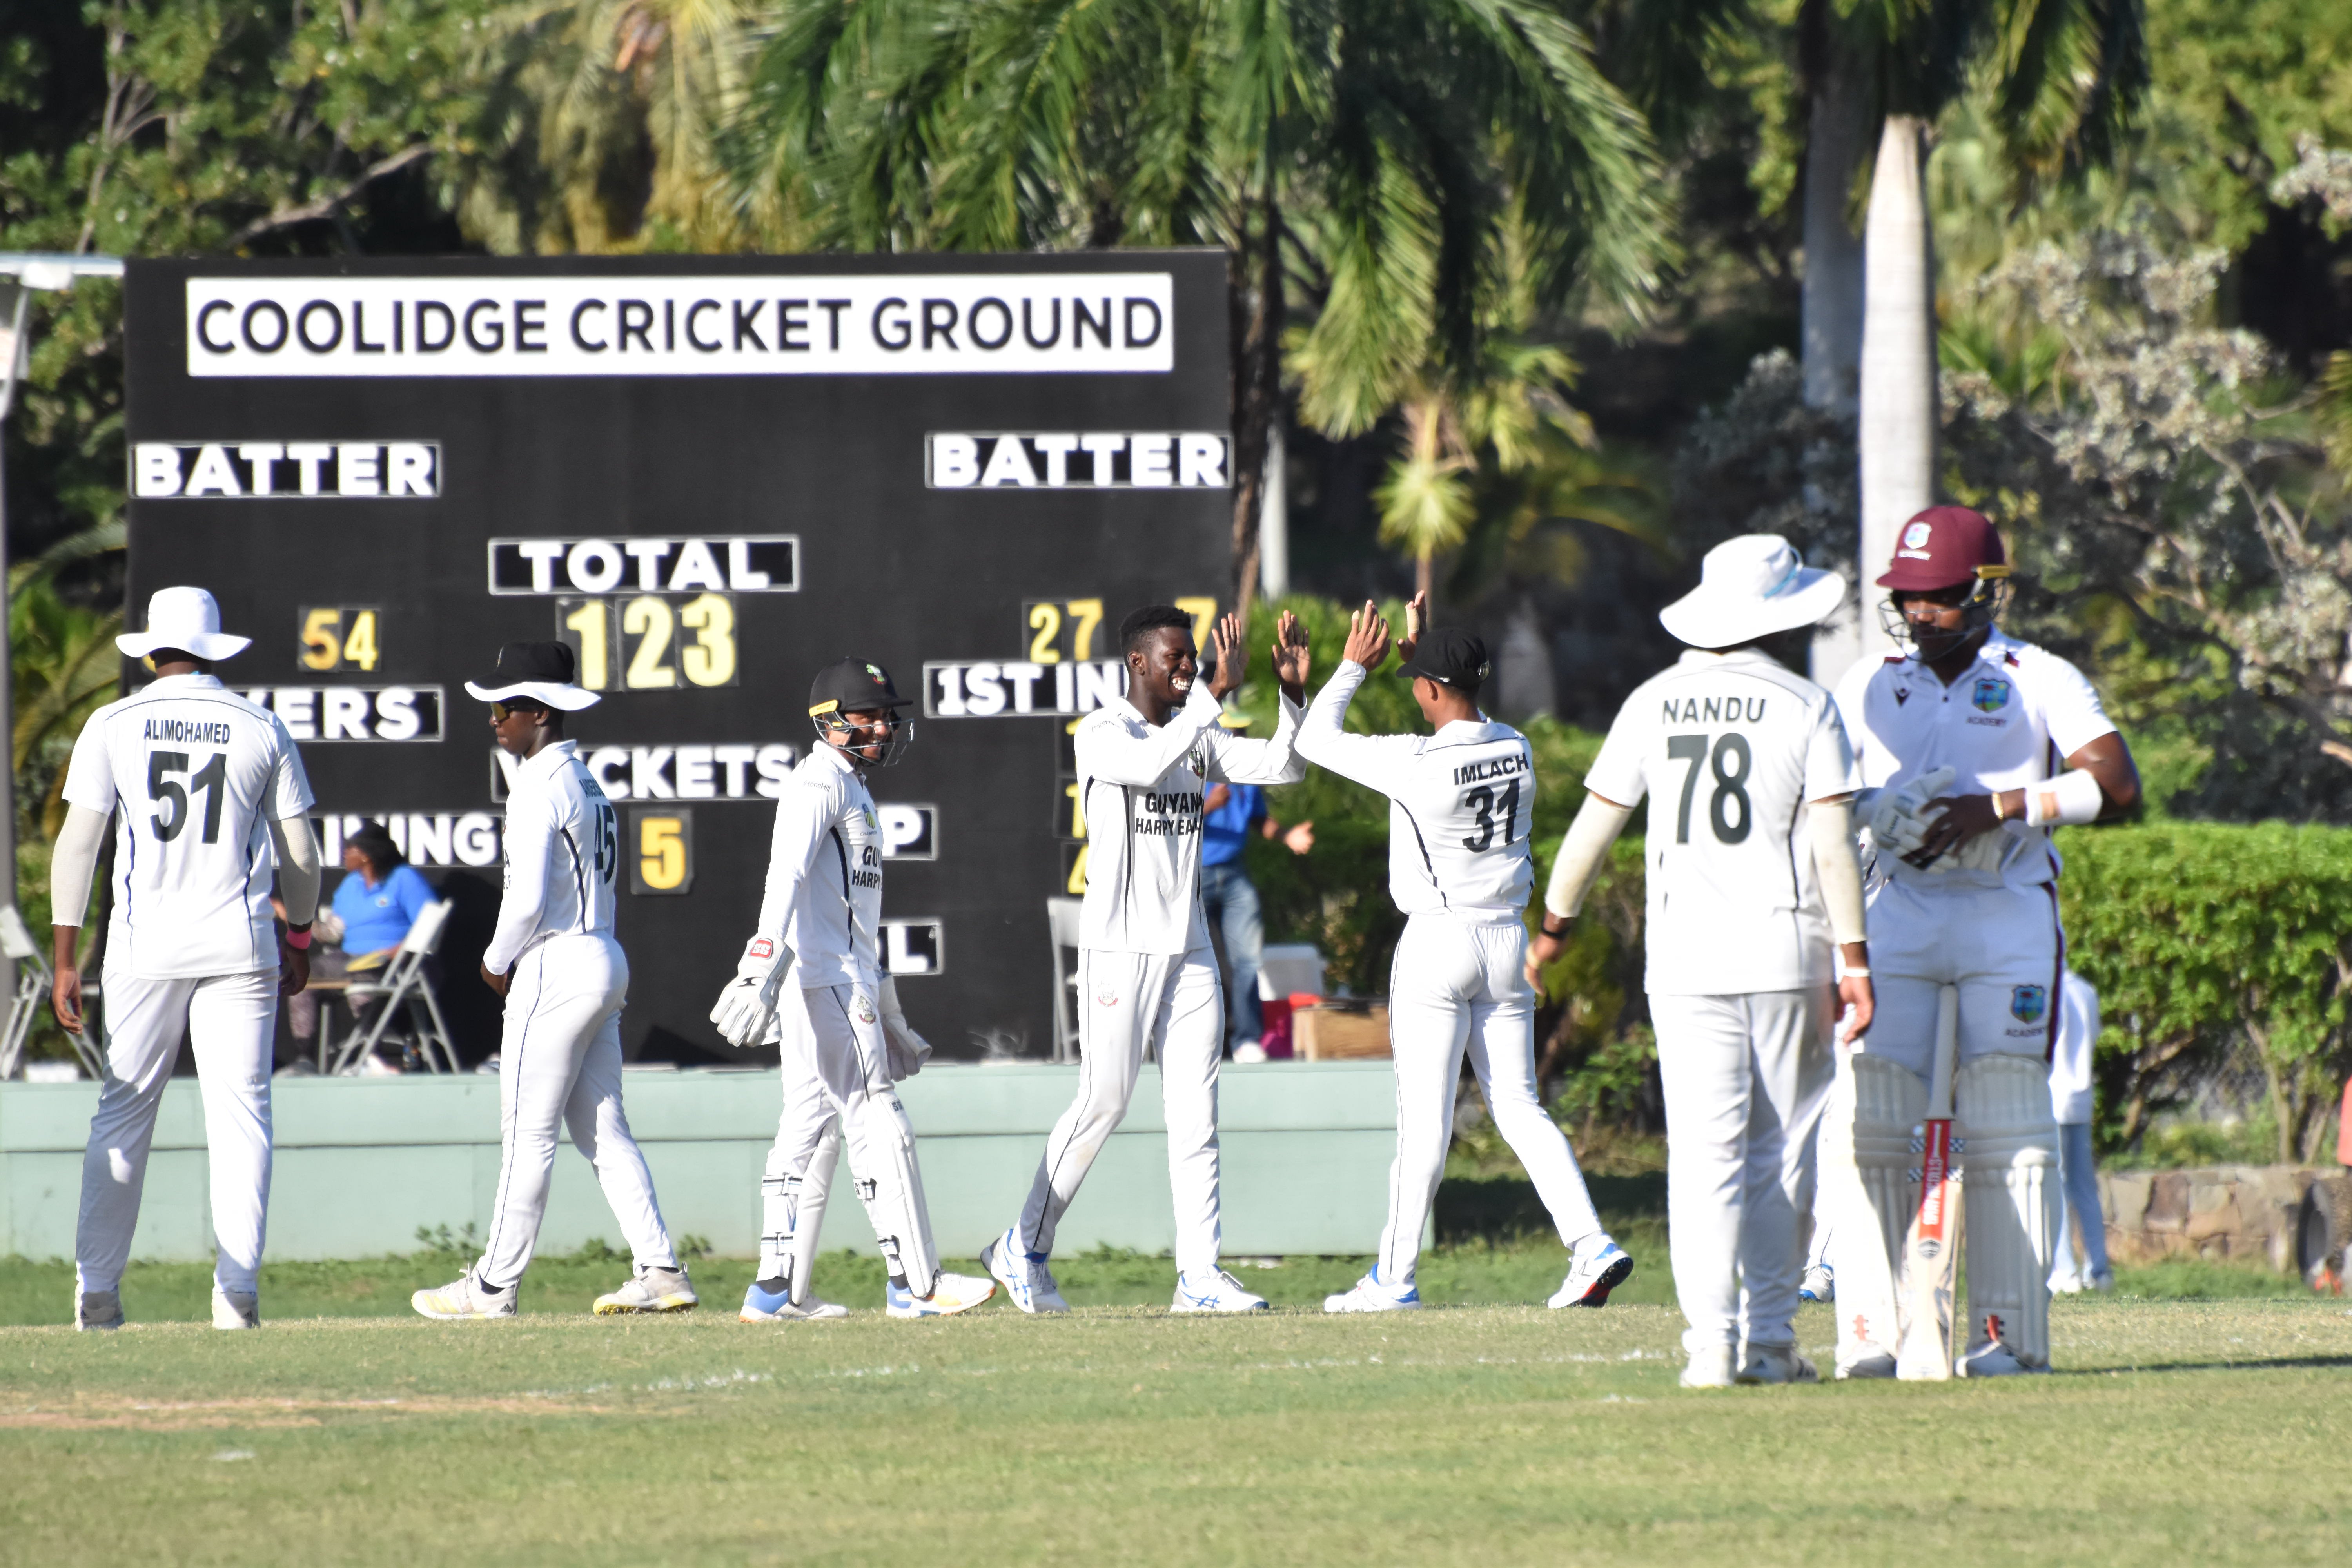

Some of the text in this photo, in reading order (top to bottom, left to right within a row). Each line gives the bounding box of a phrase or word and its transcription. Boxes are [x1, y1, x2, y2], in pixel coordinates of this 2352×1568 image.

[196, 296, 1163, 354] COOLIDGE CRICKET GROUND
[134, 441, 435, 497] BATTER
[932, 432, 1227, 488] BATTER
[517, 537, 771, 594] TOTAL
[301, 608, 379, 668] 54
[566, 593, 736, 689] 123
[1029, 598, 1103, 664] 27
[247, 688, 420, 740] ERS
[938, 662, 1043, 716] 1ST
[1662, 697, 1766, 724] NANDU
[144, 719, 231, 745] ALIMOHAMED
[496, 745, 795, 799] CKETS
[1454, 753, 1529, 786] IMLACH
[1667, 732, 1751, 845] 78
[147, 751, 226, 845] 51
[1462, 778, 1520, 853] 31
[594, 804, 616, 884] 45
[641, 817, 686, 890] 5
[1135, 818, 1174, 836] HARPY
[851, 869, 880, 891] HARPY
[752, 944, 771, 956] SS
